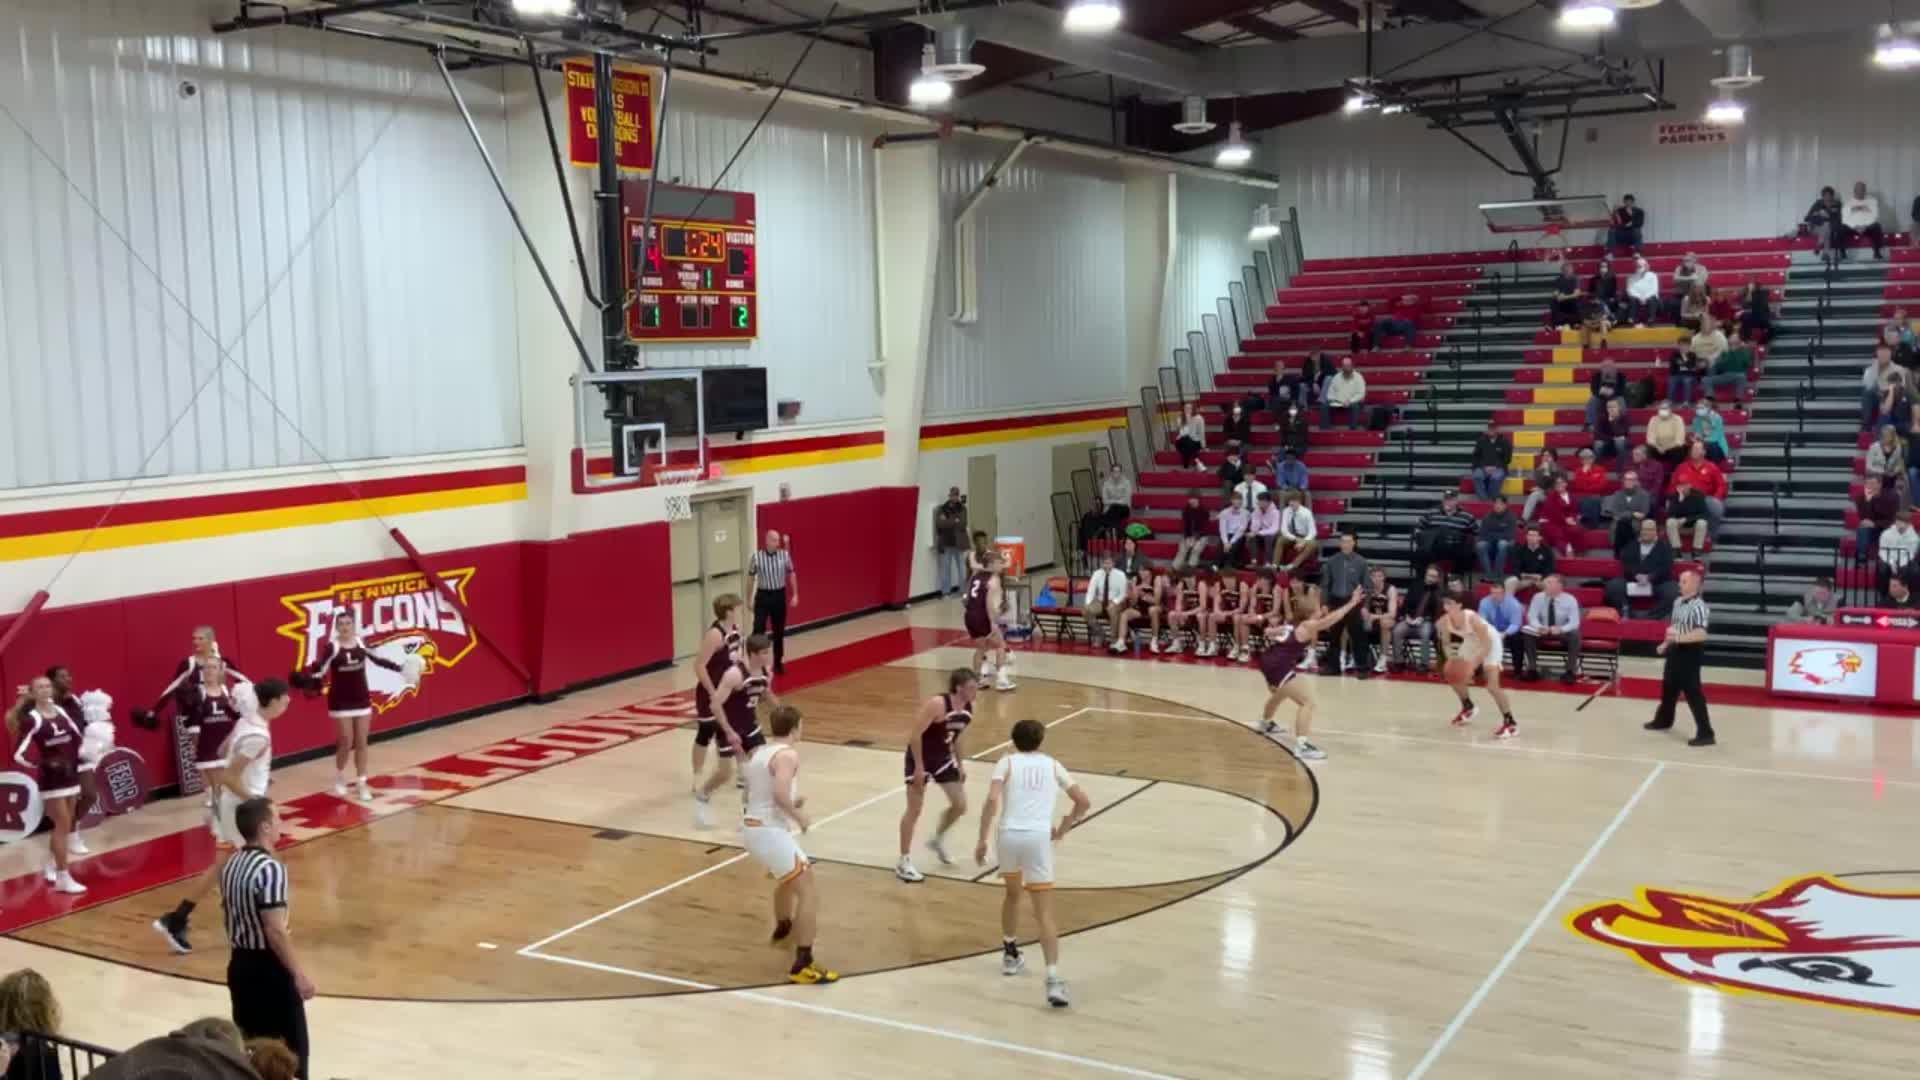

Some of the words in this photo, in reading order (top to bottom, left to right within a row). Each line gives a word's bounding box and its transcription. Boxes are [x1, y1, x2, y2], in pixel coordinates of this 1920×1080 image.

[738, 305, 748, 328] 2
[338, 577, 431, 602] FENWICK
[971, 579, 981, 598] 2
[212, 701, 225, 715] L
[51, 722, 66, 736] L
[104, 759, 140, 804] FEAR
